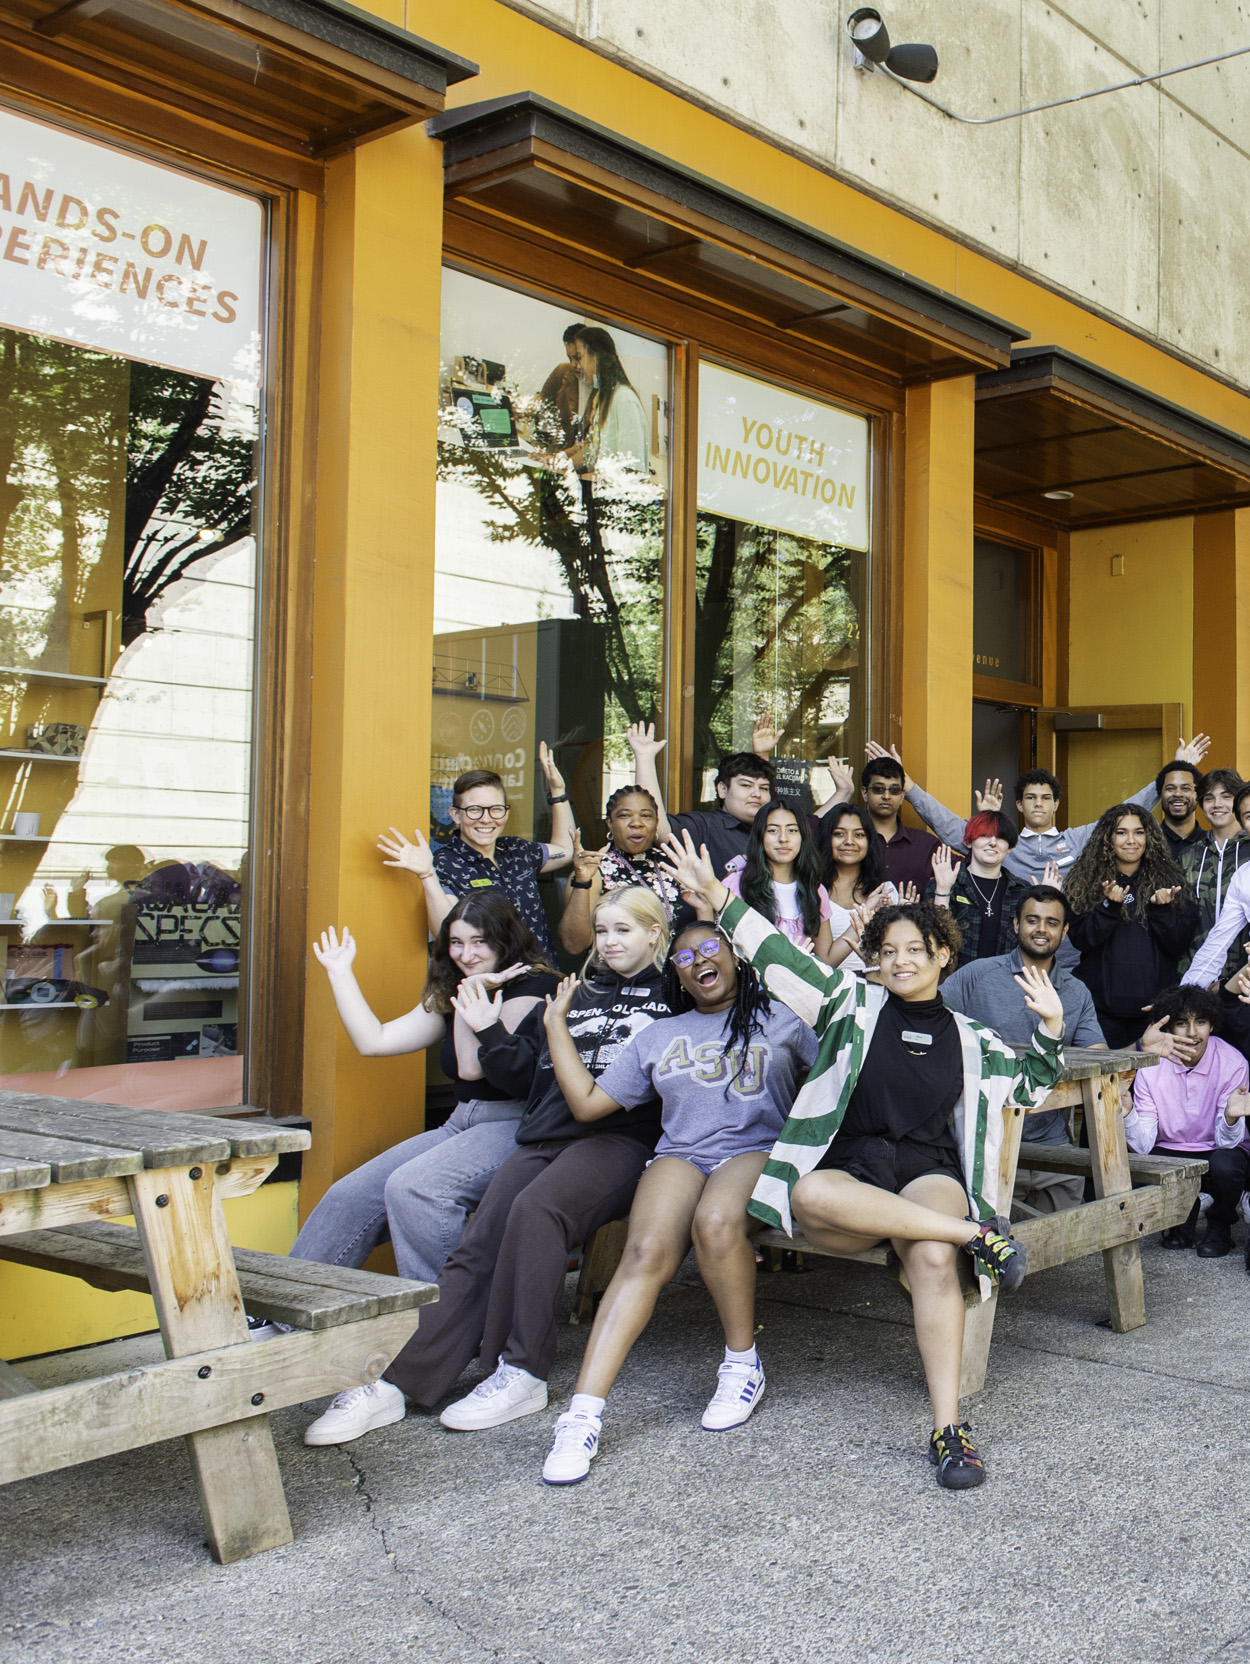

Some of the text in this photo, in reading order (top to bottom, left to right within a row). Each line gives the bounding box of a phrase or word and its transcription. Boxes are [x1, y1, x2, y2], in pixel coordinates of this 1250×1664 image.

[0, 226, 240, 324] ERIENCES
[742, 416, 826, 467] YOUTH
[705, 442, 856, 510] INNOVATION
[974, 654, 1000, 668] enue
[656, 1035, 770, 1100] ASU
